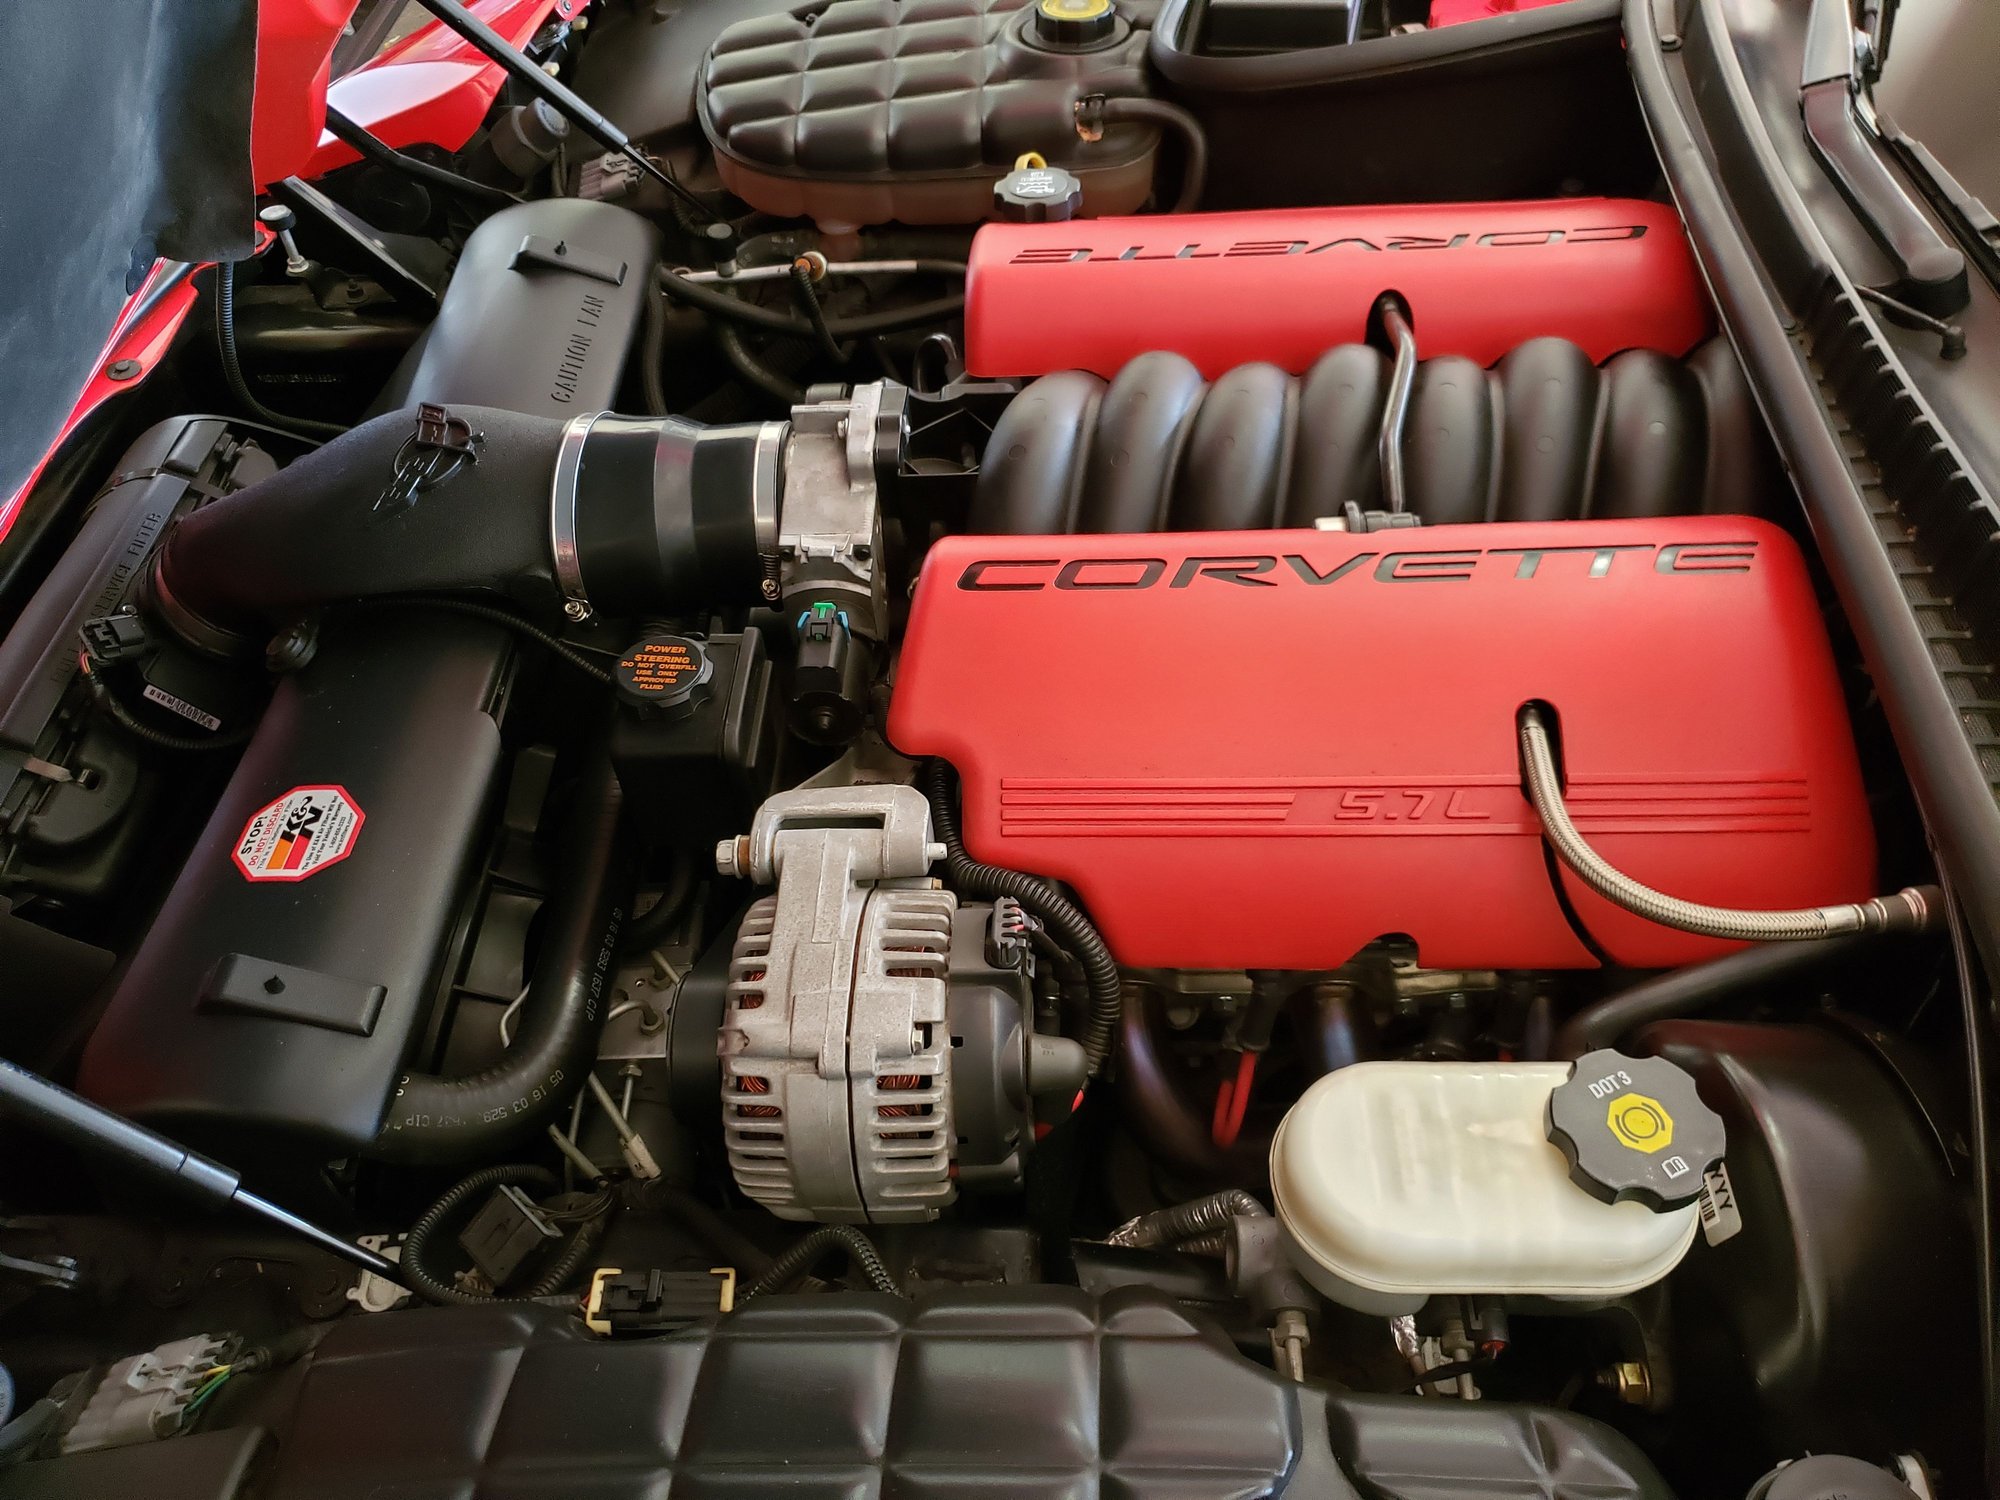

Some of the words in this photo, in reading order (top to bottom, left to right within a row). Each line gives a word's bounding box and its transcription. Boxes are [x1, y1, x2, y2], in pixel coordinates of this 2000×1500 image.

[1009, 225, 1648, 264] CORVETTE
[551, 333, 592, 403] CAUTION
[957, 541, 1759, 591] CORVETTE
[634, 654, 690, 664] STEERING
[644, 644, 687, 654] POWER
[658, 663, 698, 671] OVERFILL
[632, 676, 677, 684] APPROVED
[1334, 790, 1490, 820] 5.7L
[241, 815, 268, 855] STOP!
[248, 855, 259, 866] DO
[255, 838, 268, 853] NOT
[263, 802, 284, 835] DISCARD
[549, 1069, 565, 1087] 05
[1587, 1075, 1620, 1100] DOT
[1617, 1070, 1633, 1086] 3
[512, 1097, 529, 1113] 03
[532, 1085, 548, 1101] 16
